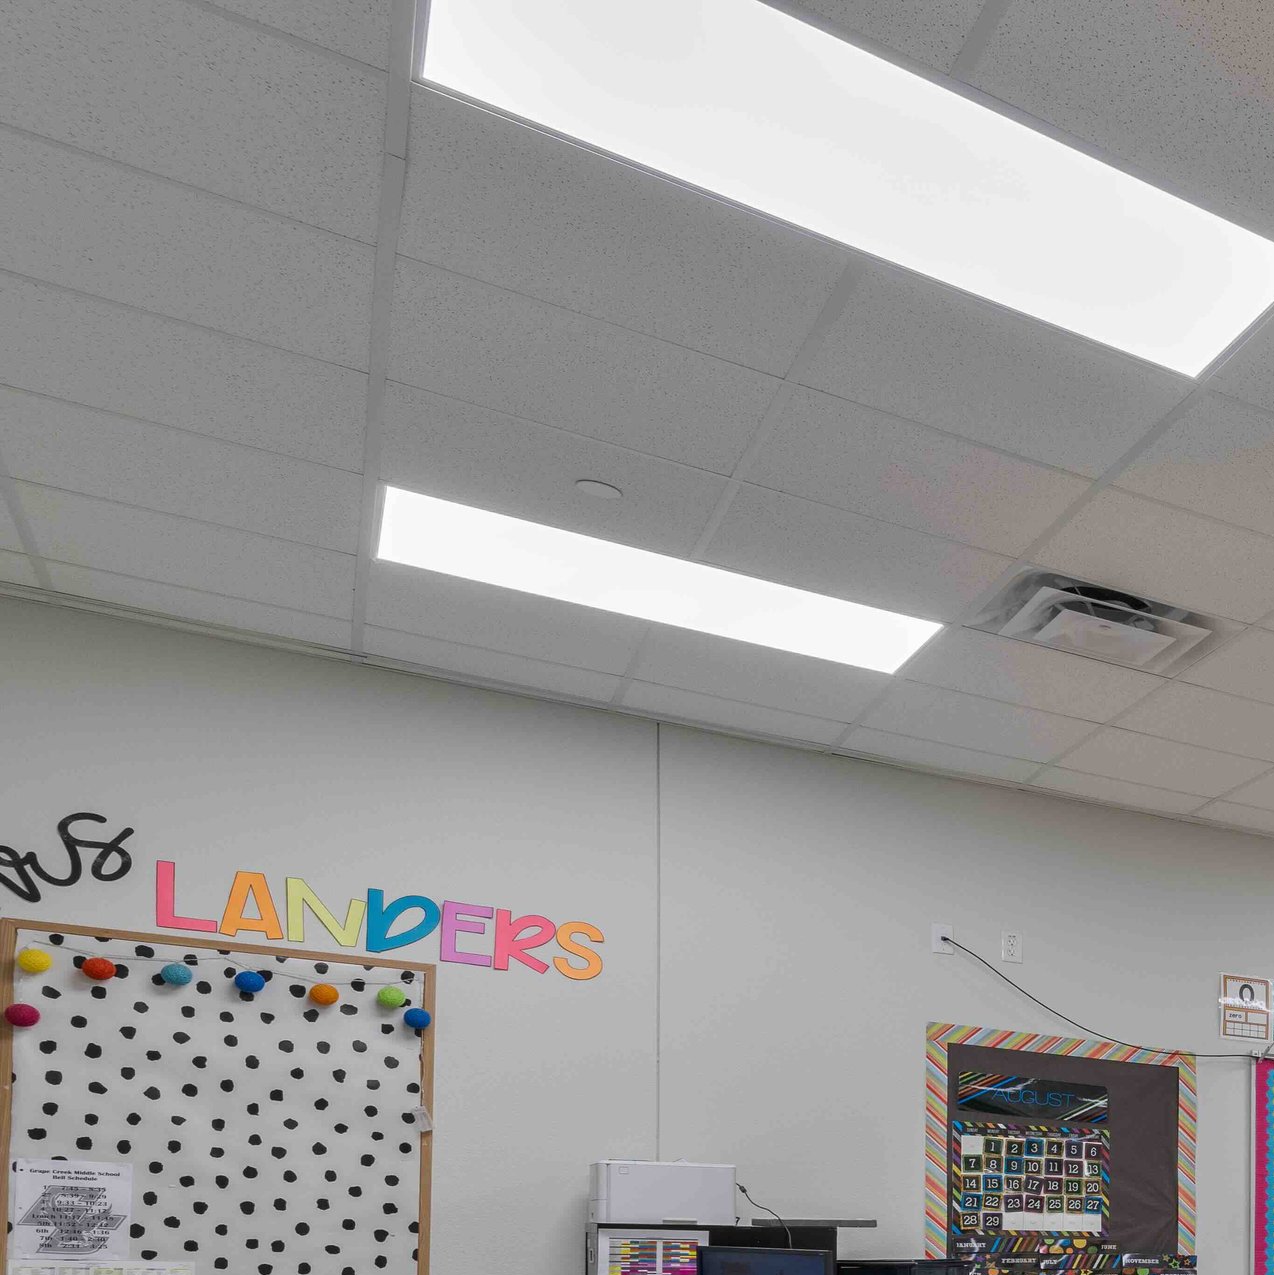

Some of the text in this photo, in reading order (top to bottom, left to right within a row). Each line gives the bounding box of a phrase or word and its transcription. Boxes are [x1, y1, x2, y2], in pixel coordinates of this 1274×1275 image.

[156, 860, 605, 980] LANDERS
[1239, 983, 1255, 1004] 0
[992, 1088, 1075, 1108] AUGUST
[991, 1142, 1097, 1156] 1 2 3 4 5 6
[969, 1159, 1098, 1174] 7 8 9 10 11 12 13
[966, 1179, 1098, 1192] 14 15 16 17 18 19 20
[965, 1197, 1099, 1210] 21 22 23 24 25 26 27
[964, 1216, 999, 1226] 28 29
